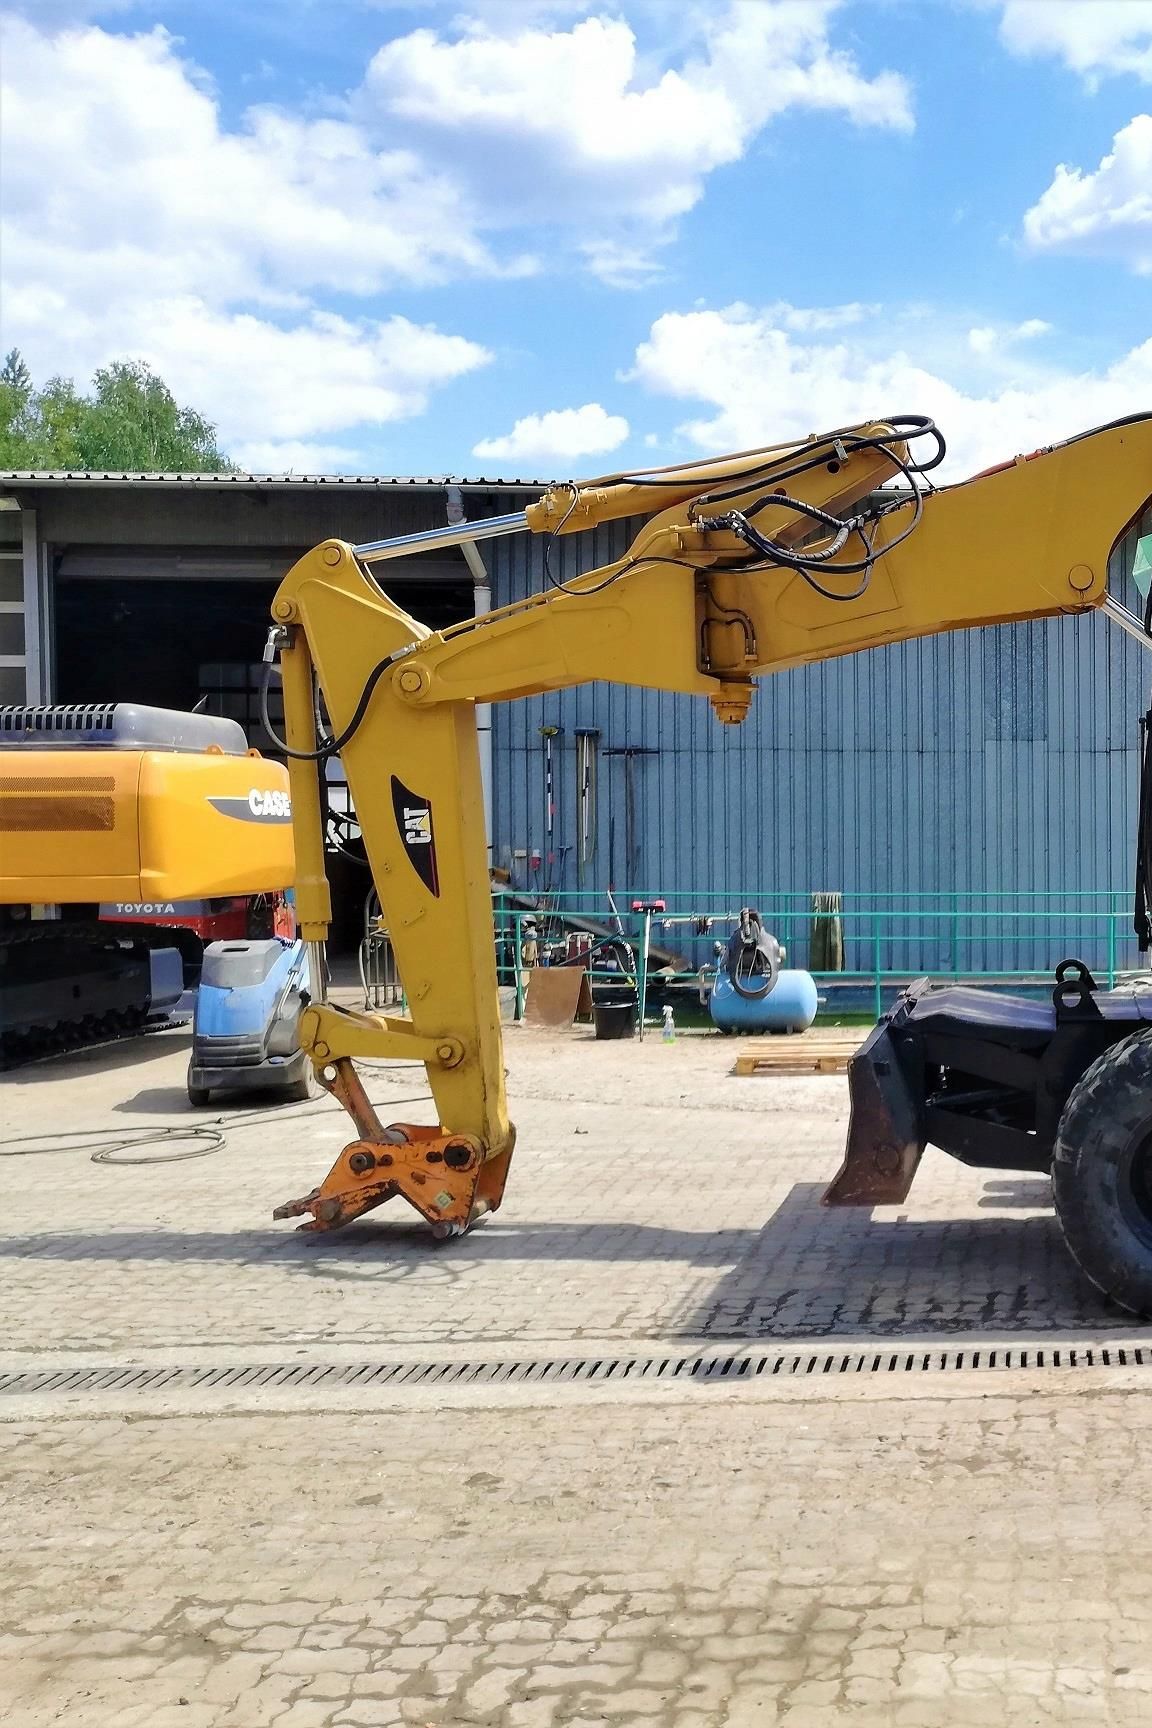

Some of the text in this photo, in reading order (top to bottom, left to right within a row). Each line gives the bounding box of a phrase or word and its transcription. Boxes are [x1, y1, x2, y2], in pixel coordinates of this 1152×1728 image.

[249, 789, 291, 817] CASE
[403, 807, 432, 844] CAT
[116, 903, 175, 913] TOYOTA
